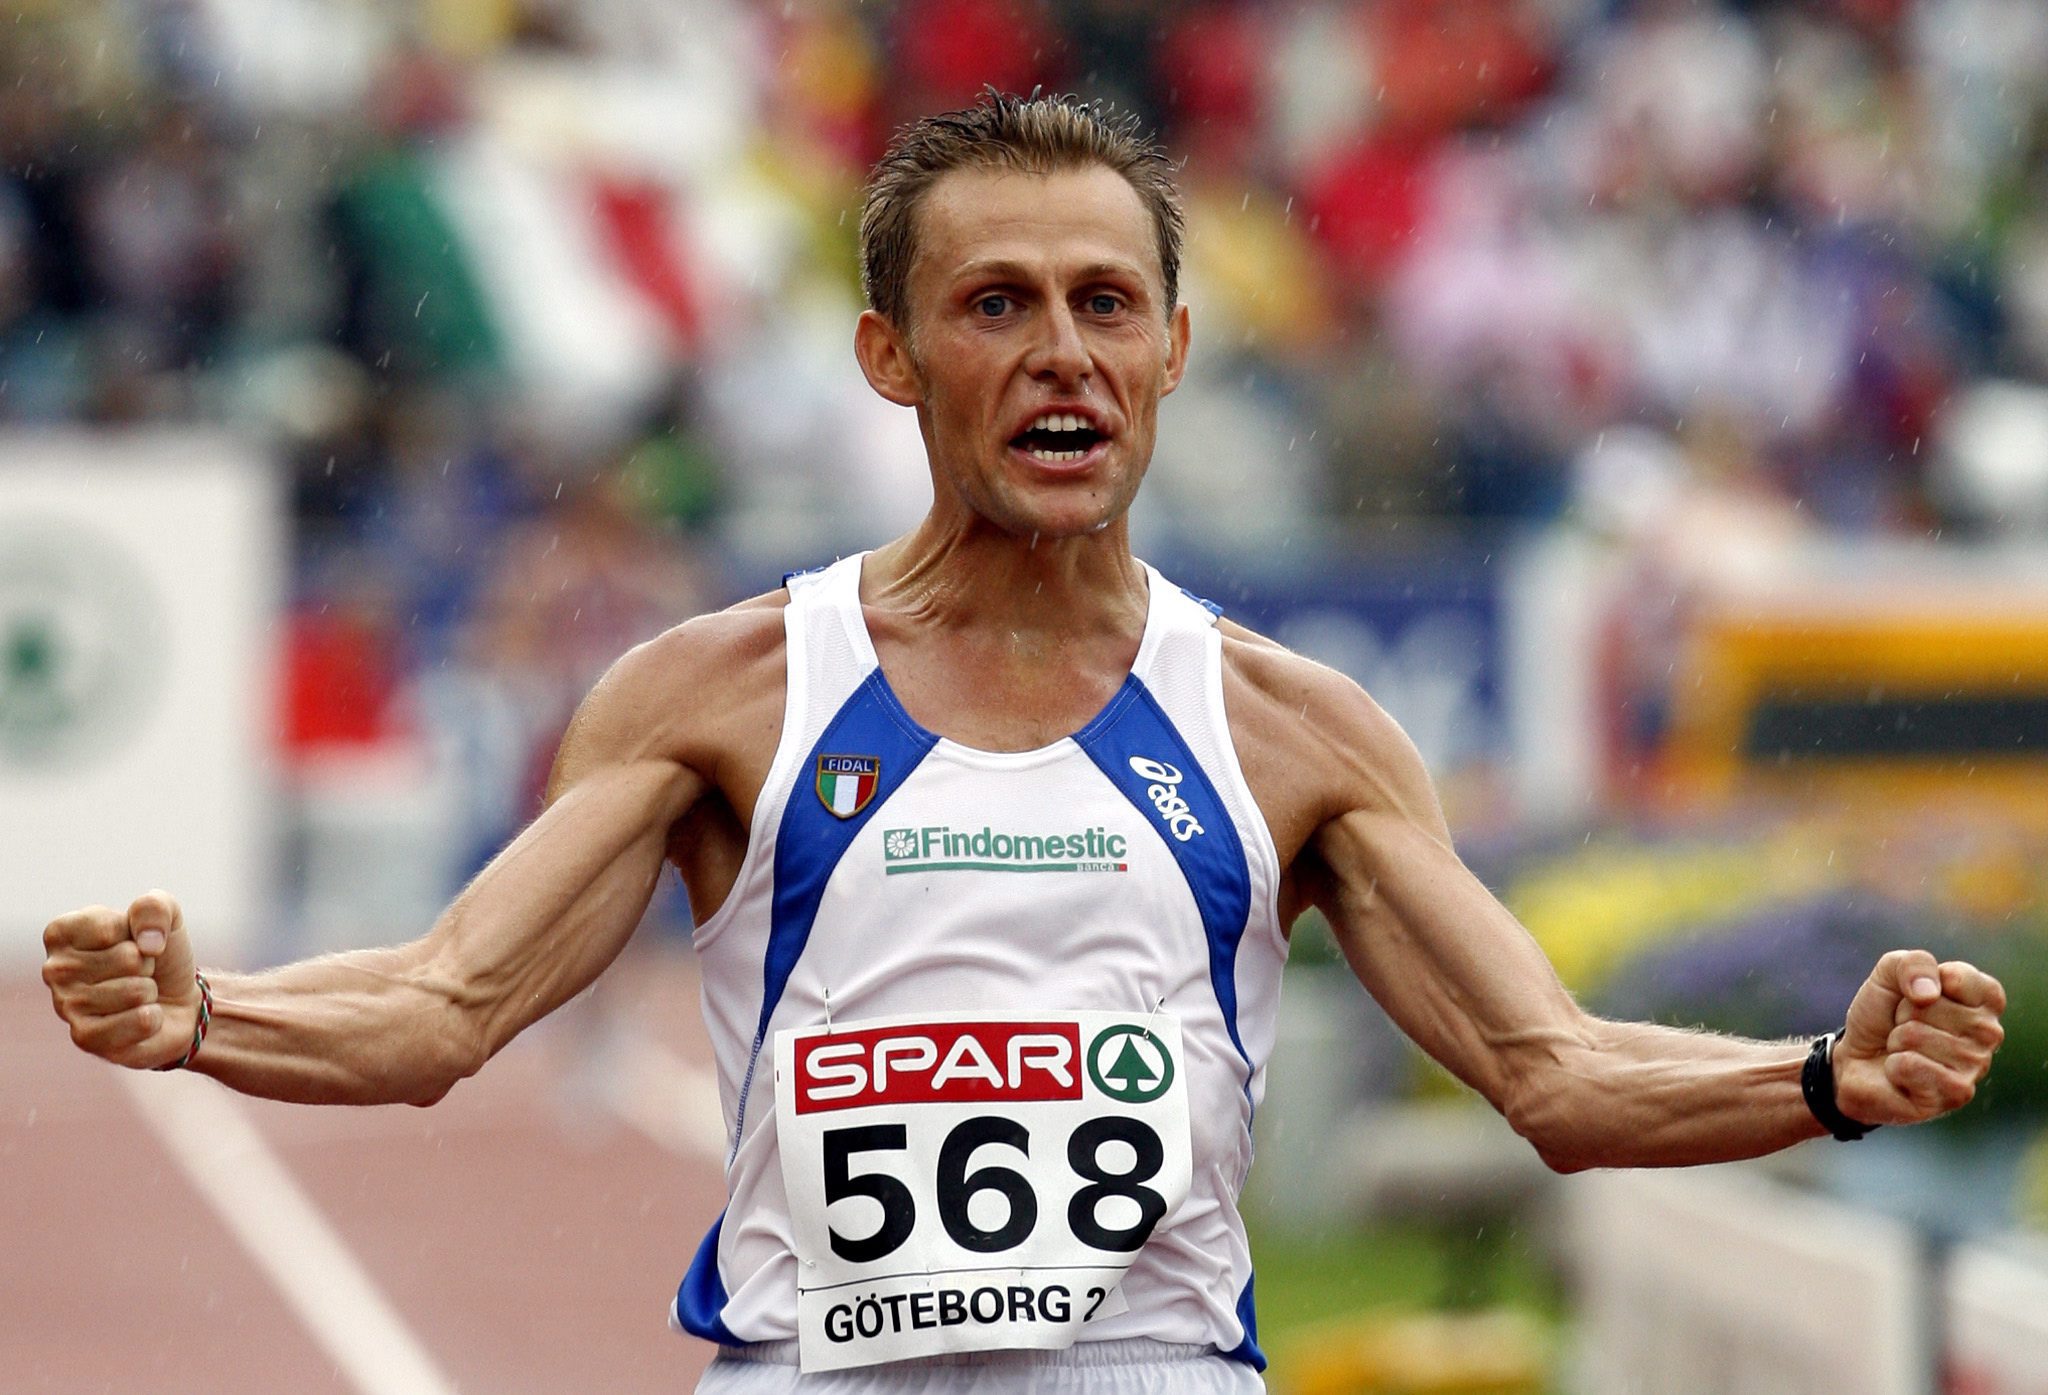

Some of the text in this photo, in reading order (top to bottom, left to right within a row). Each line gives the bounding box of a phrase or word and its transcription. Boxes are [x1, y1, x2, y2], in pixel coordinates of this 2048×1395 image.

[828, 758, 872, 772] FIDAL
[1147, 783, 1205, 841] asics
[921, 826, 1127, 859] Findomestic
[805, 1033, 1075, 1101] SPAR
[822, 1115, 1168, 1263] 568
[824, 1284, 1112, 1343] GÖTEBORG 2
